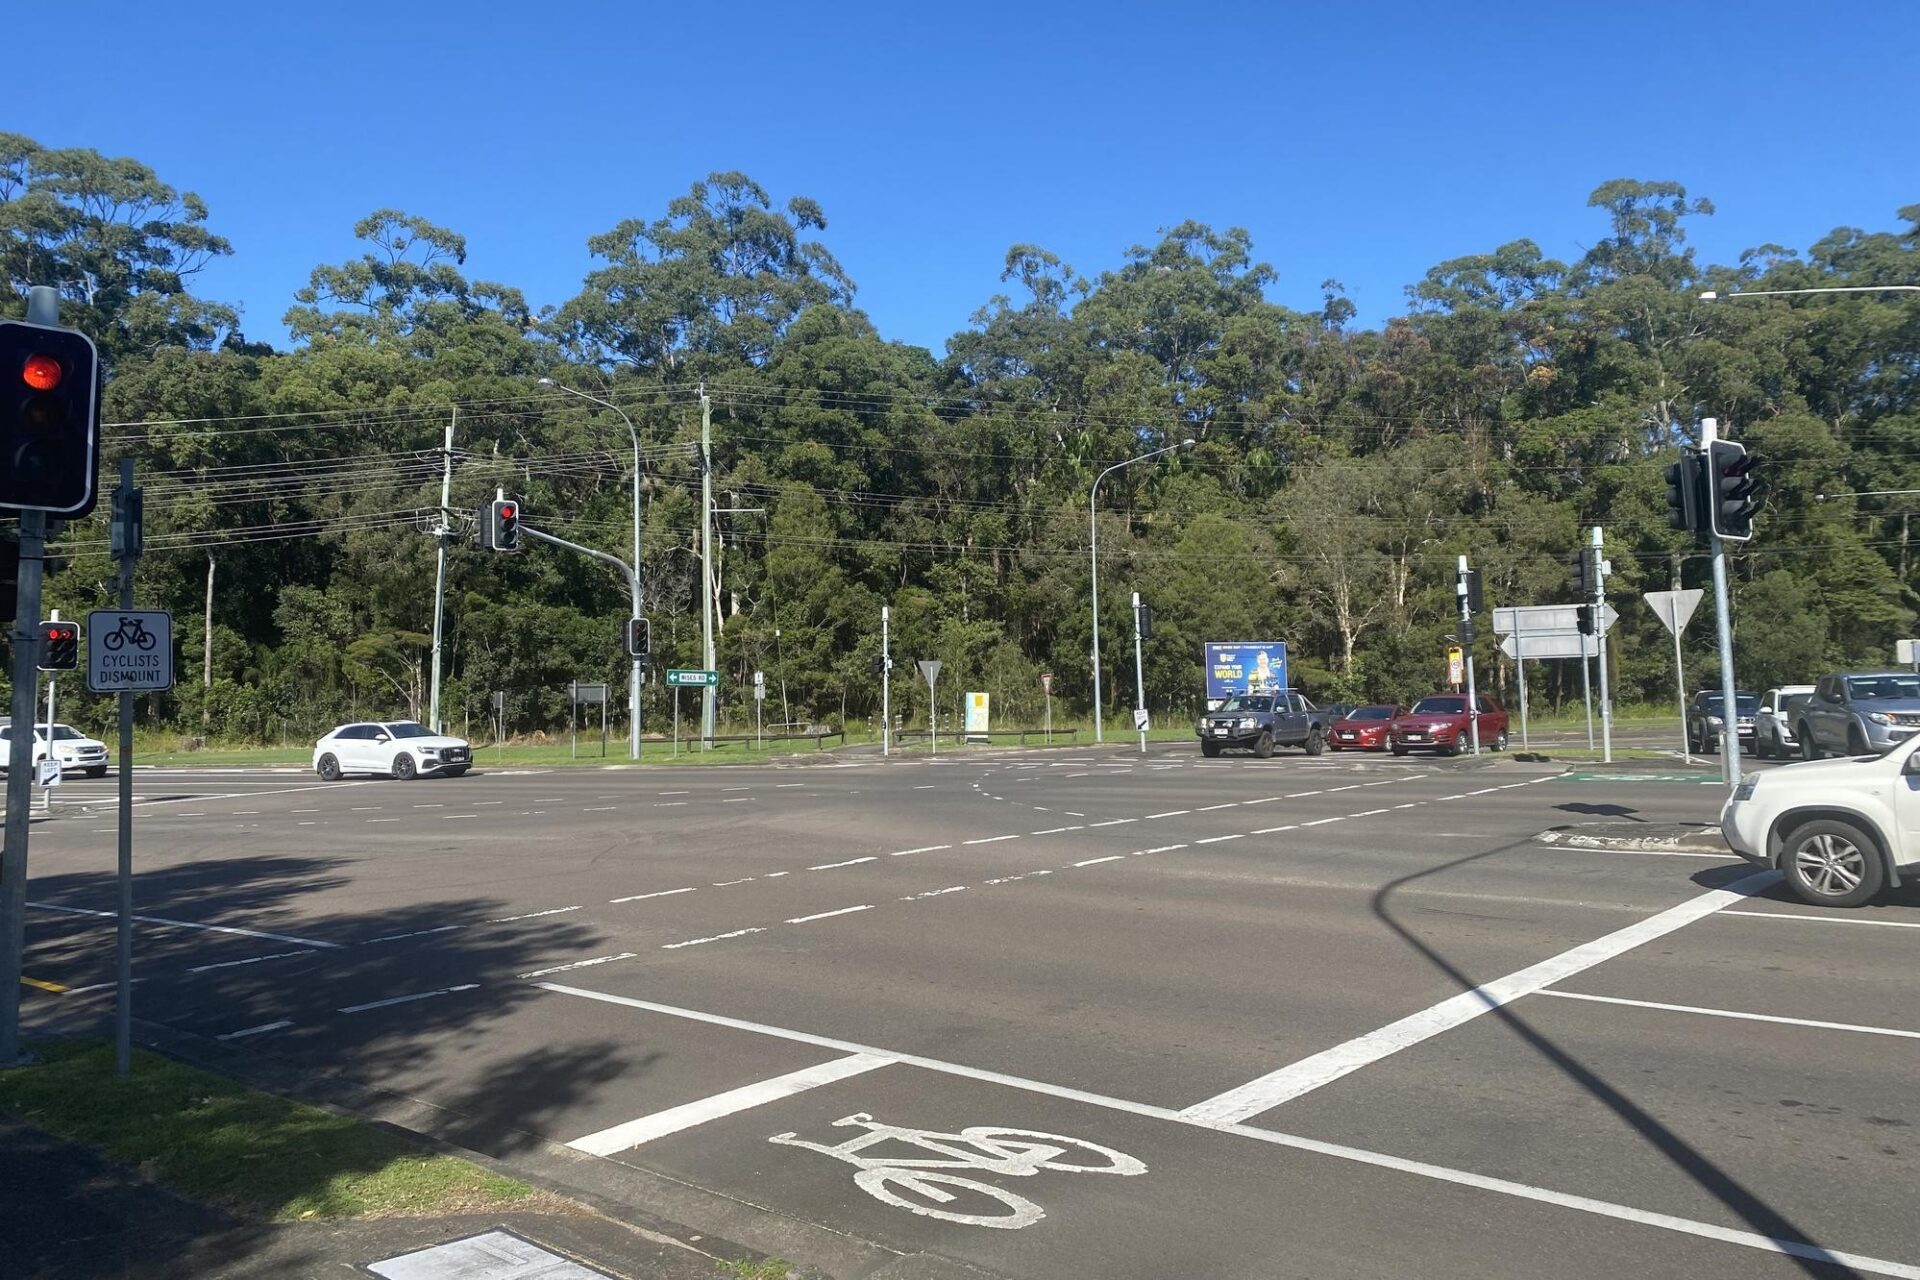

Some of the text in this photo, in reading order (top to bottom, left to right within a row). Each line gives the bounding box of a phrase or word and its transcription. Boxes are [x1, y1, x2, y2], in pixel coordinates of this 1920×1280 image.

[103, 655, 159, 667] CYCLISTS
[101, 671, 160, 683] DISMOUNT
[1215, 670, 1243, 678] WORLD
